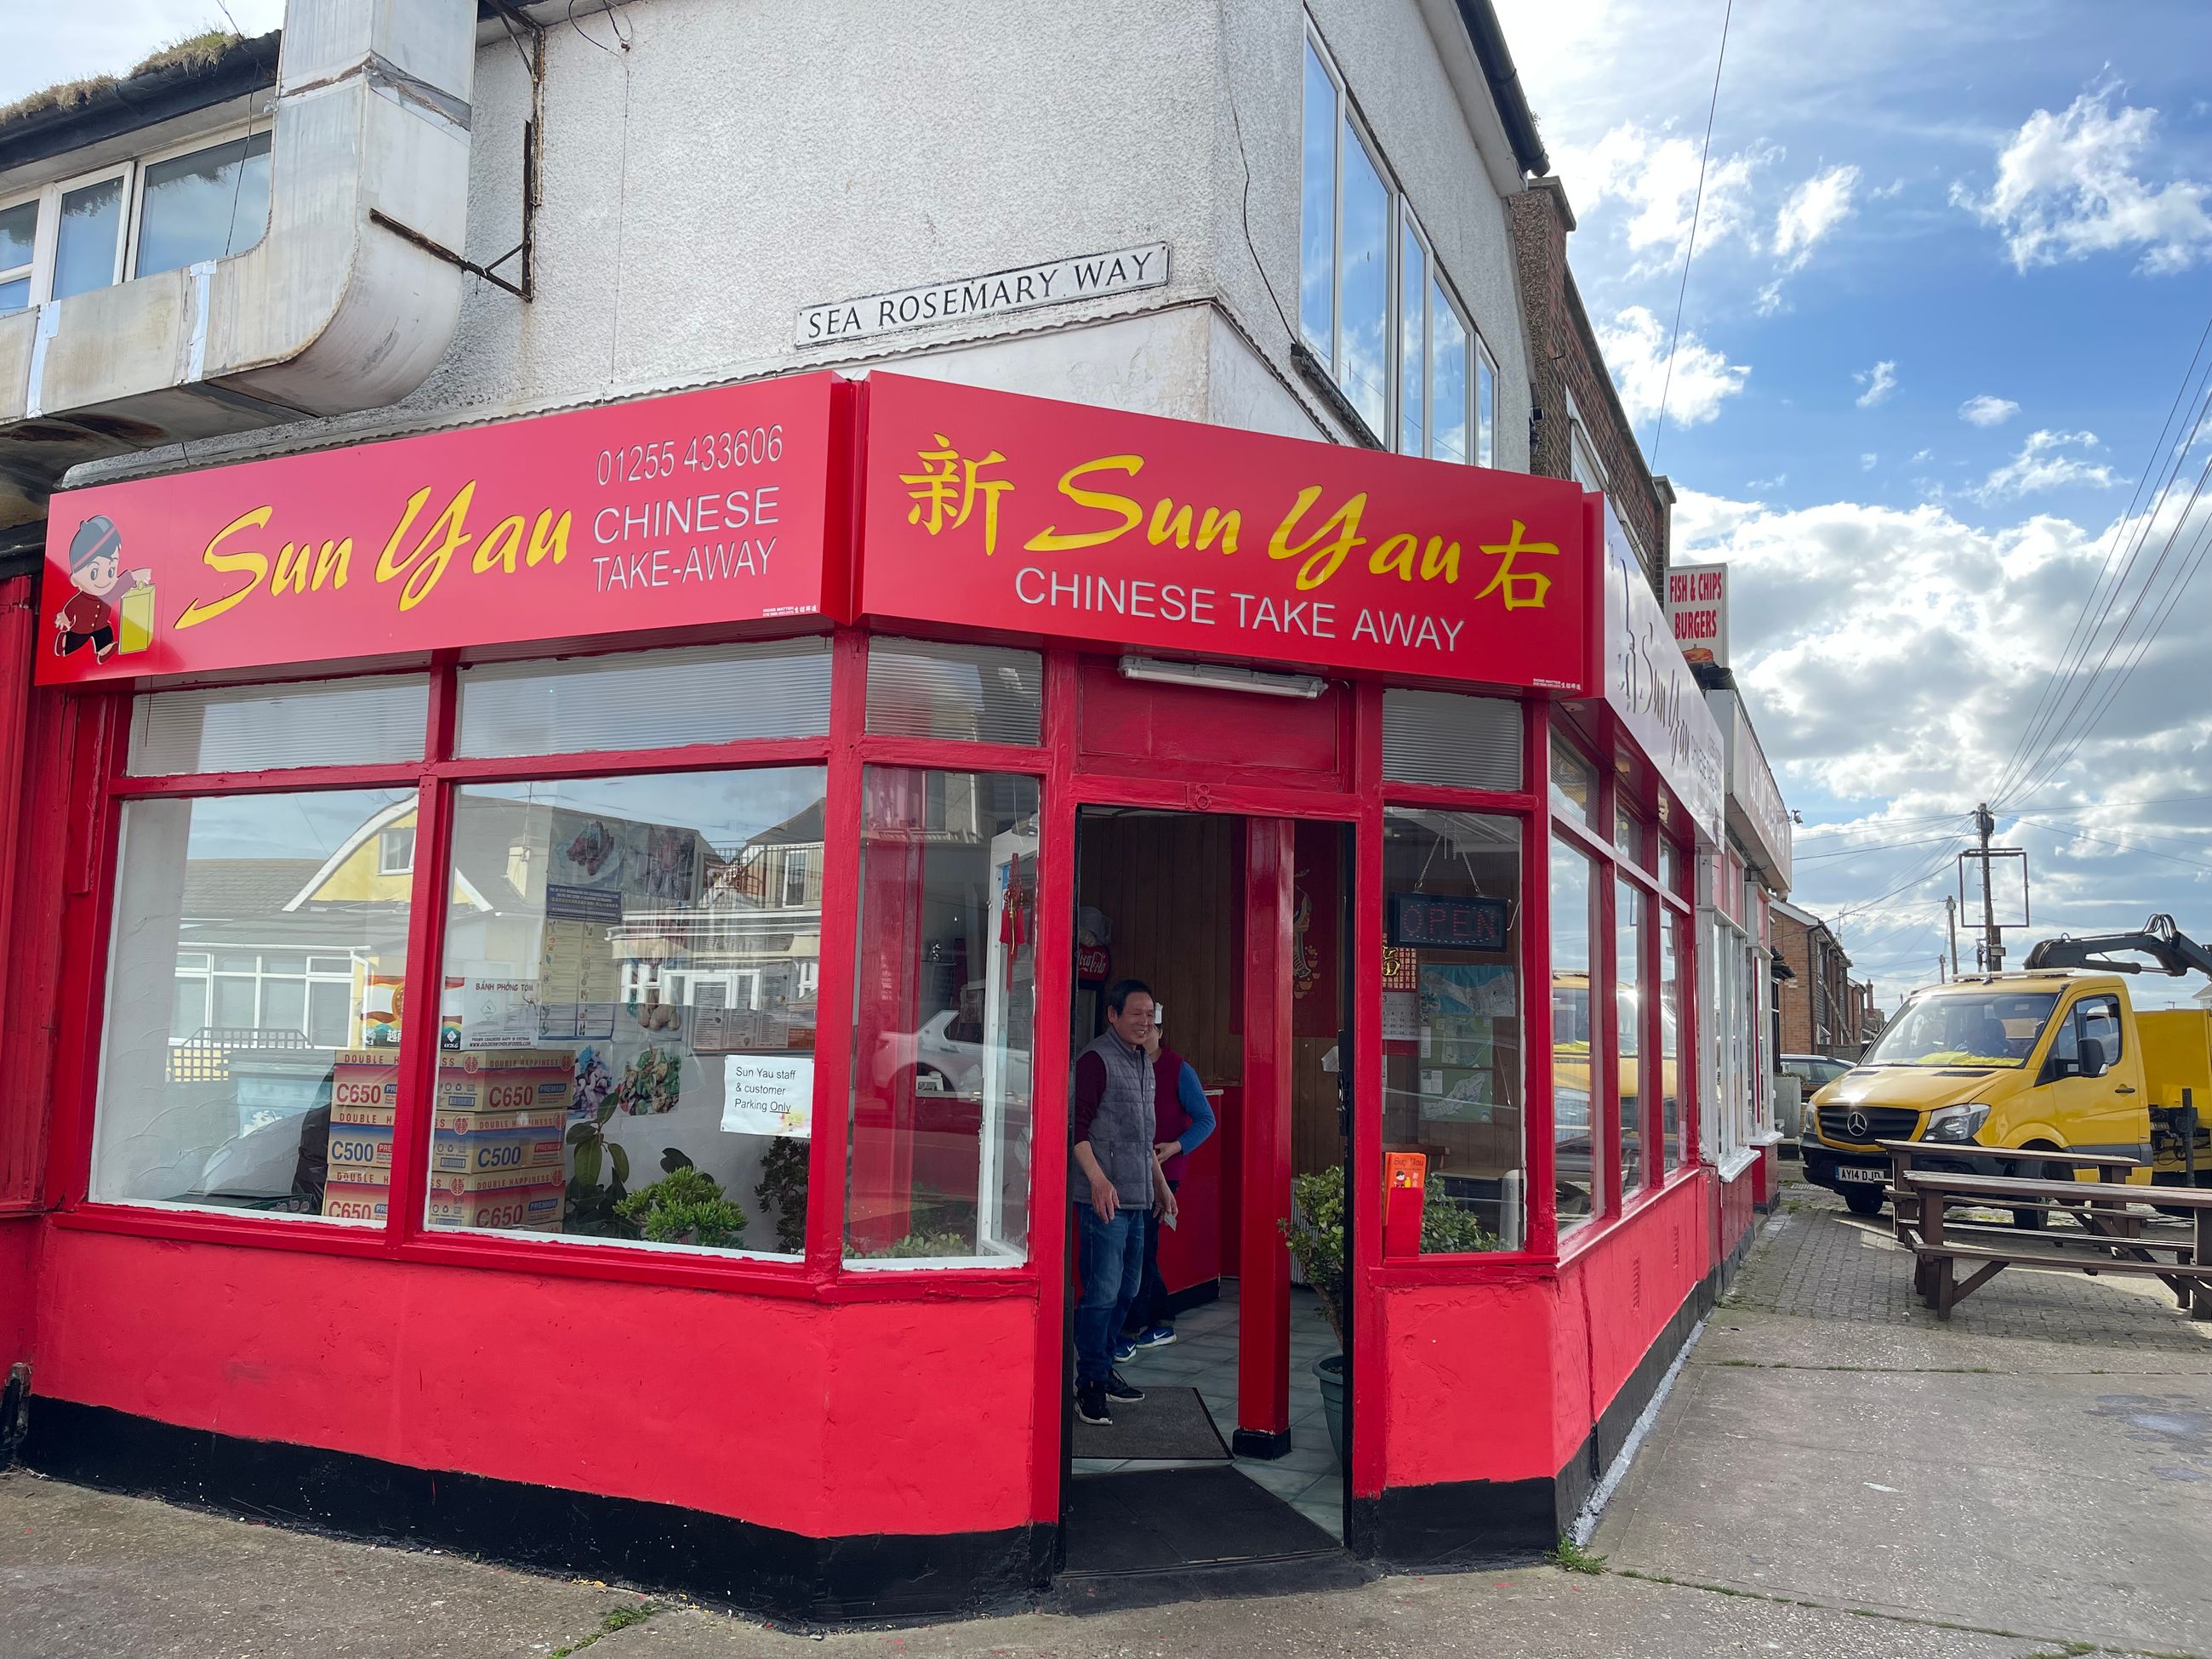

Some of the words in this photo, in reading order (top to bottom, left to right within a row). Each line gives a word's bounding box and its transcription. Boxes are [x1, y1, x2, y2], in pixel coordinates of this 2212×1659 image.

[808, 306, 862, 339] SEA
[878, 268, 1059, 328] ROSEMARY
[1075, 252, 1154, 290] WAY
[596, 434, 676, 487] 01255
[682, 423, 784, 472] 433606
[593, 485, 780, 546] CHINESE
[898, 432, 1016, 557] 新
[1023, 453, 1242, 553] Sun
[1268, 483, 1461, 592] Yau
[1474, 517, 1561, 612] 右
[173, 504, 353, 630] Sun
[373, 478, 573, 613] Yau
[592, 535, 778, 594] TAKE-AWAY
[1669, 574, 1688, 603] FISH
[1690, 573, 1696, 602] &
[1698, 571, 1722, 601] CHIPS
[1015, 566, 1216, 627] CHINESE
[1230, 591, 1337, 641] TAKE
[1351, 608, 1466, 653] AWAY
[1674, 608, 1717, 641] BURGERS
[1403, 907, 1497, 937] OPEN
[345, 1054, 384, 1064] DOUBLE
[489, 1059, 516, 1068] DOUBLE
[520, 1058, 559, 1067] HAPPINESS
[735, 1066, 754, 1077] Sun
[756, 1068, 774, 1079] Yau
[776, 1069, 796, 1080] staff
[336, 1083, 381, 1103] C650
[489, 1085, 533, 1108] C650
[735, 1082, 742, 1092] &
[744, 1084, 786, 1095] customer
[734, 1097, 767, 1113] Parking
[769, 1101, 791, 1113] Only
[339, 1113, 377, 1123] DOUBLE
[479, 1120, 509, 1129] DOUBLE
[331, 1140, 374, 1162] C500
[477, 1146, 522, 1168] C500
[337, 1172, 374, 1183] DOUBLE
[476, 1178, 506, 1189] DOUBLE
[509, 1174, 550, 1186] HAPPINESS
[1841, 1169, 1860, 1180] AY14
[328, 1201, 372, 1220] C650
[476, 1204, 524, 1228] C650
[529, 1199, 558, 1211] PREMIUM
